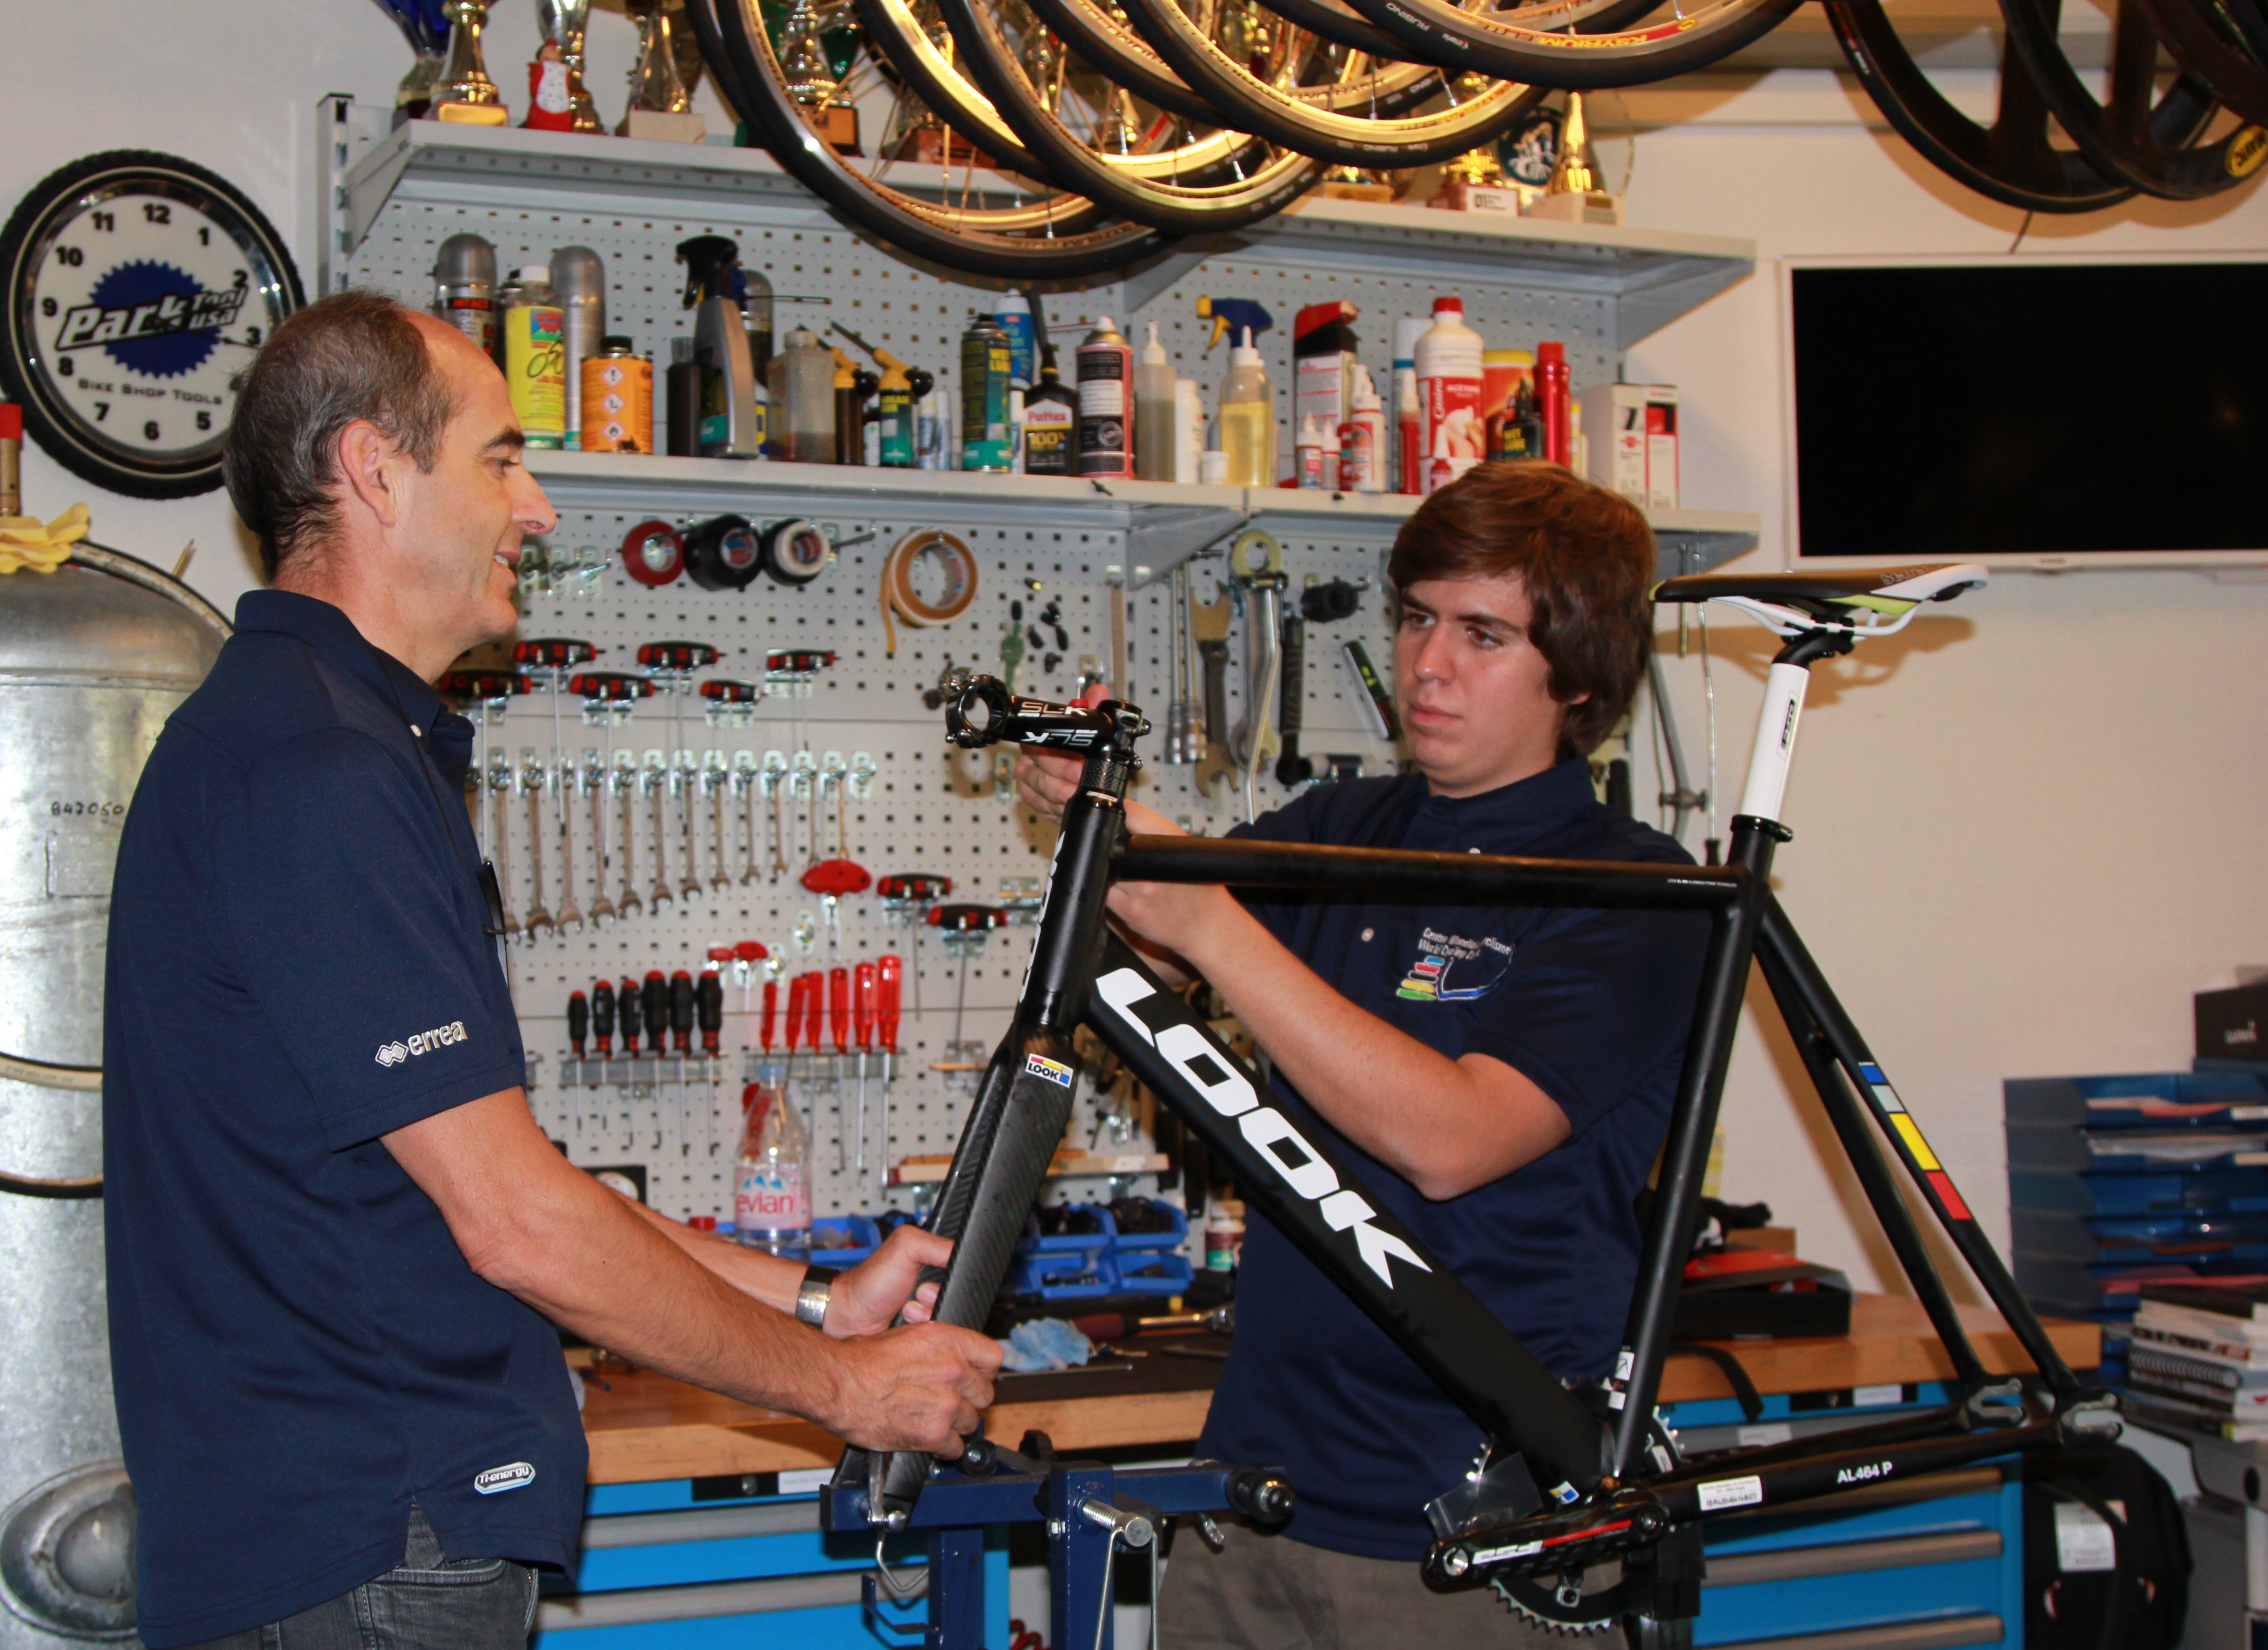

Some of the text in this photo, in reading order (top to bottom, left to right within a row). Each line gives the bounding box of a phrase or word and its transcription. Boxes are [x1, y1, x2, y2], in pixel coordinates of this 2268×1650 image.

[1385, 3, 1430, 31] RUBINO
[92, 212, 115, 232] 11
[143, 205, 170, 224] 12
[198, 229, 210, 245] 1
[56, 246, 83, 266] 10
[235, 270, 247, 287] 2
[41, 298, 57, 315] 9
[58, 294, 184, 350] Park
[246, 327, 261, 345] 3
[57, 357, 74, 376] 8
[1434, 377, 1443, 419] Casino
[94, 403, 110, 420] 7
[144, 421, 159, 439] 6
[196, 413, 211, 430] 5
[1019, 701, 1088, 717] SL-K
[1020, 732, 1096, 746] SL-K
[1028, 1063, 1060, 1081] LOOK
[1095, 967, 1433, 1289] LOOK
[736, 1192, 794, 1214] evian
[479, 1466, 530, 1484] Ti-energy
[1837, 1462, 1893, 1483] AL464 P
